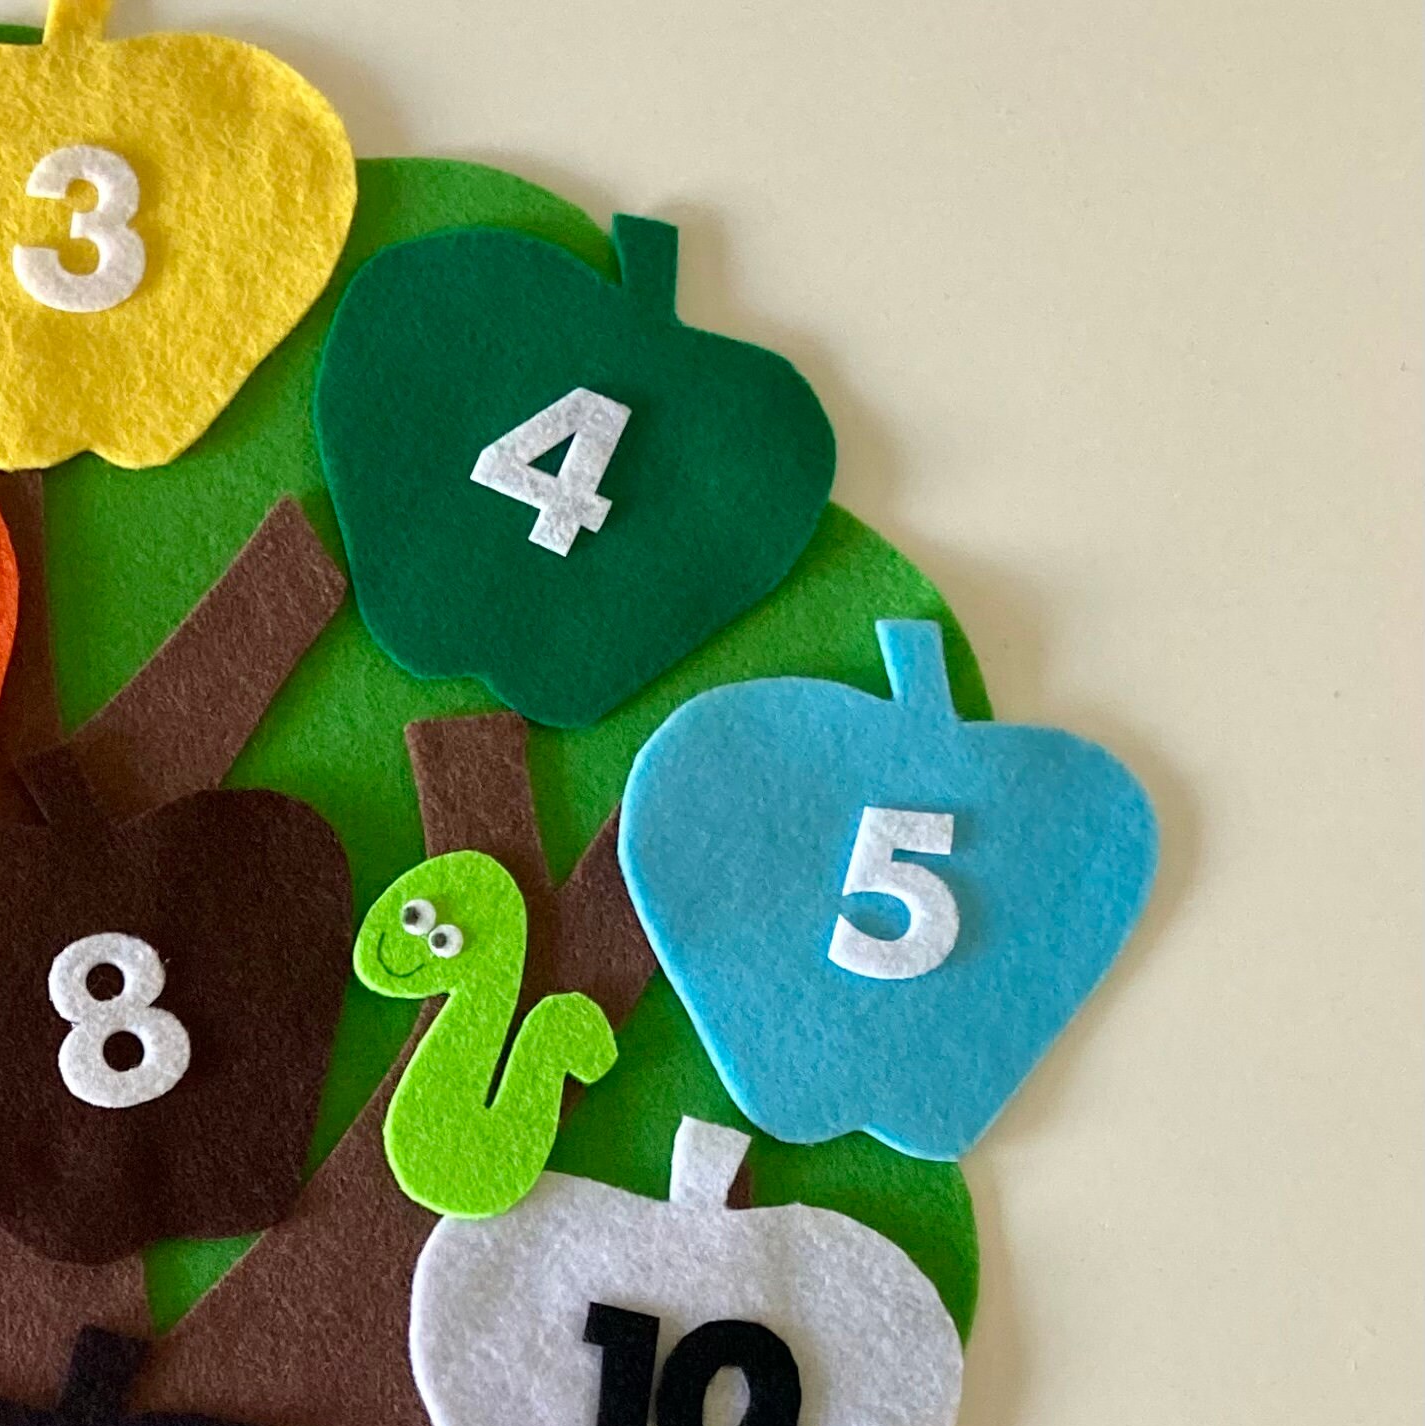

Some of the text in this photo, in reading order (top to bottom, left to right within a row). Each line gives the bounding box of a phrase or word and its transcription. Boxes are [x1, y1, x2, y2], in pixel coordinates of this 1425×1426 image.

[12, 145, 146, 312] 3
[469, 387, 631, 556] 4
[827, 806, 959, 980] 5
[48, 932, 191, 1108] 8
